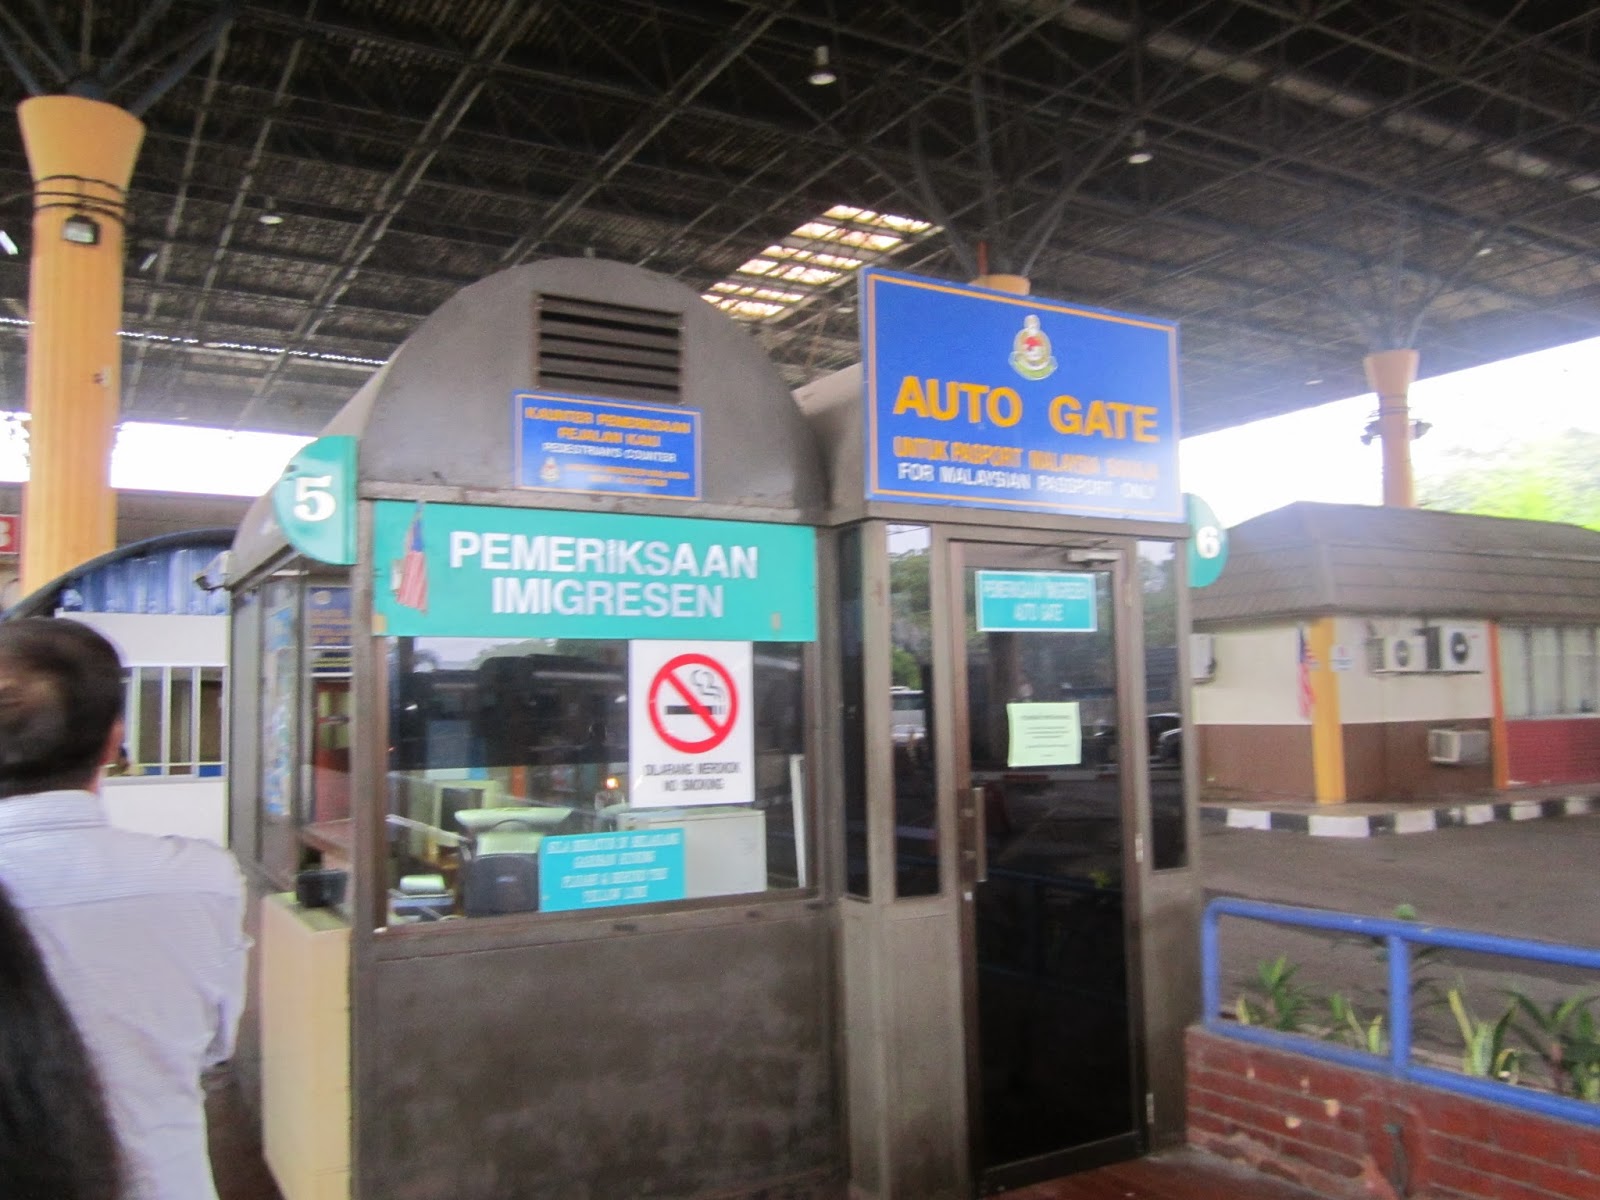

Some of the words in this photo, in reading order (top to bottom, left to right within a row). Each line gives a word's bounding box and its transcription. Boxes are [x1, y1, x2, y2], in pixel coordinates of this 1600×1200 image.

[893, 376, 1023, 428] AUTO
[1049, 395, 1160, 443] GATE
[893, 436, 948, 460] UNTUK
[898, 462, 934, 482] FOR
[940, 466, 1031, 490] MALAYSIAN
[293, 476, 336, 521] 5
[450, 531, 758, 579] PEMERIKSAAN
[1197, 527, 1221, 559] 6
[491, 577, 724, 618] IMIGRESEN
